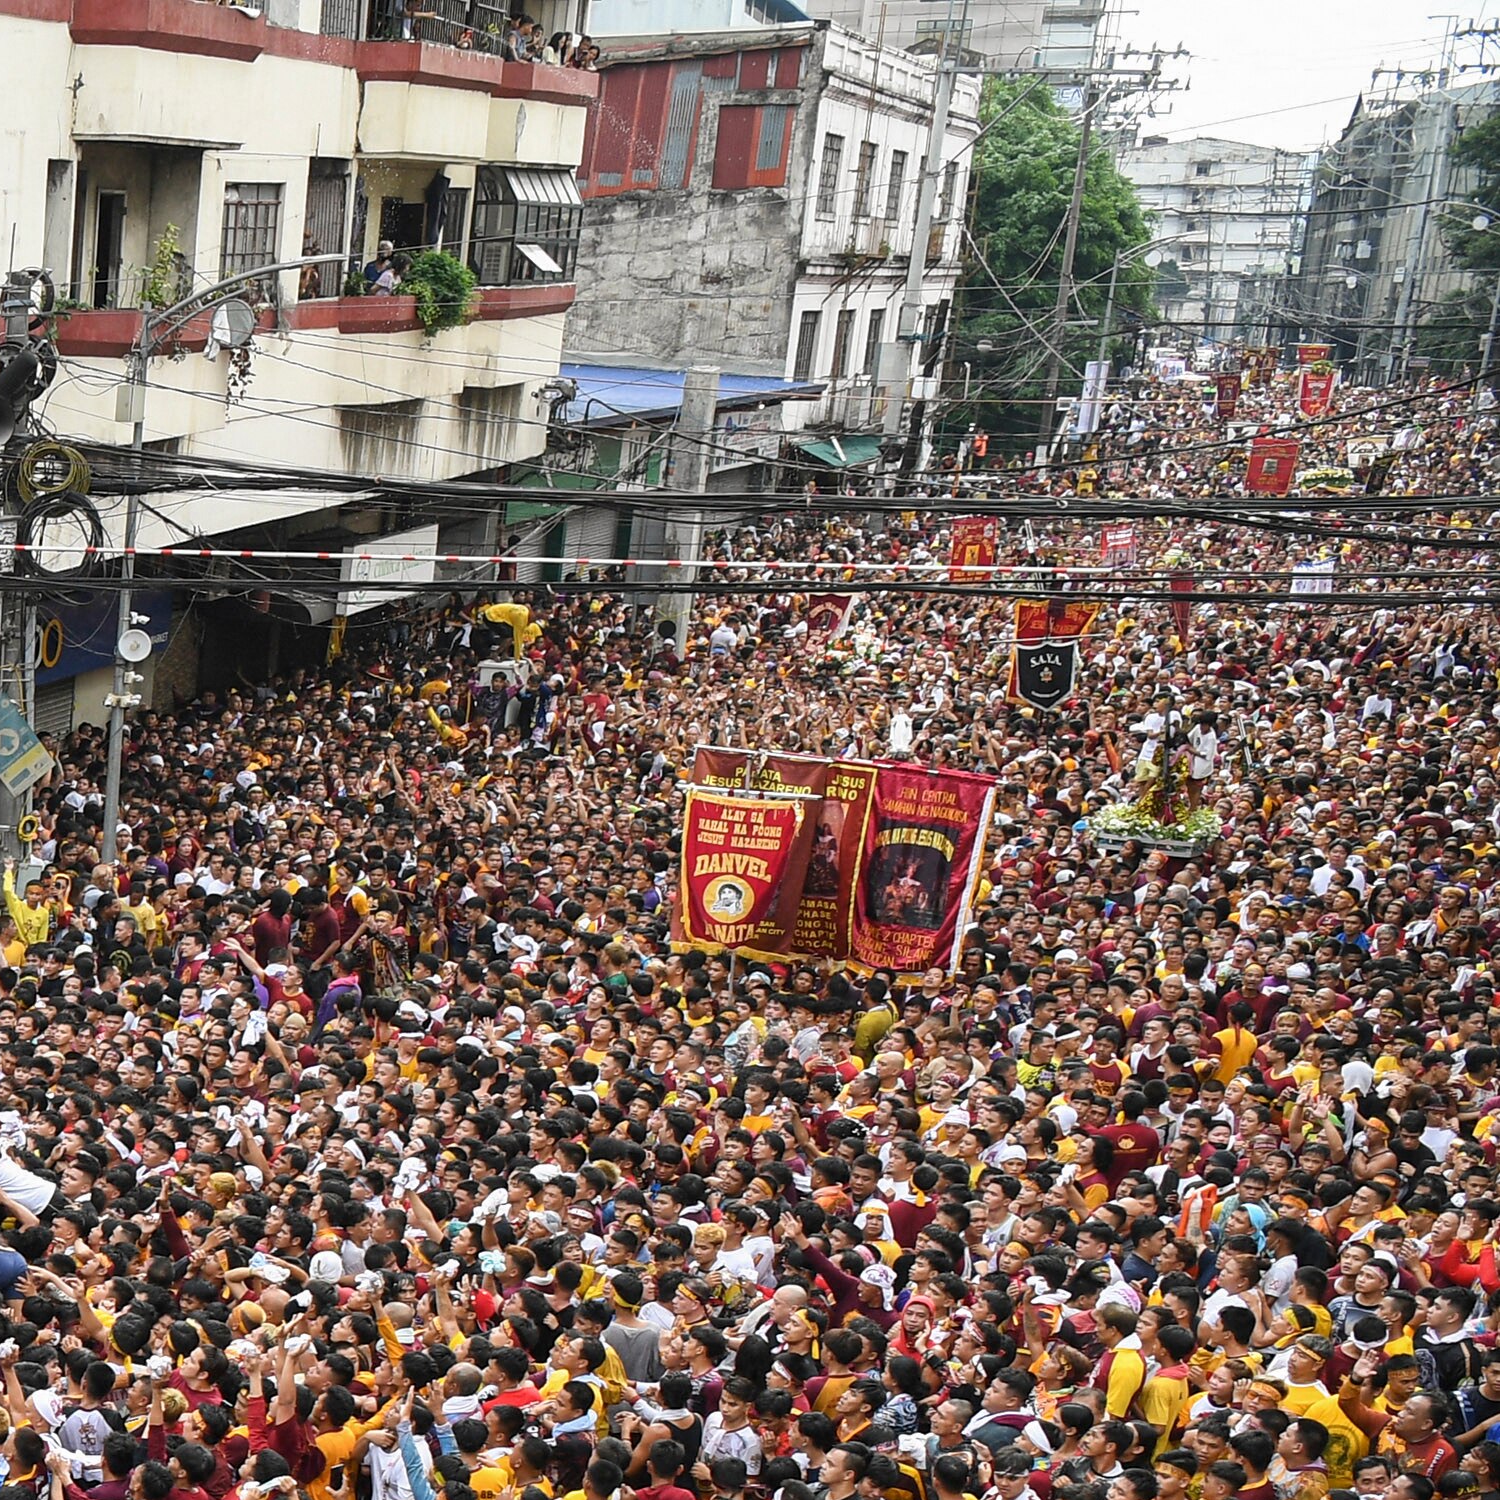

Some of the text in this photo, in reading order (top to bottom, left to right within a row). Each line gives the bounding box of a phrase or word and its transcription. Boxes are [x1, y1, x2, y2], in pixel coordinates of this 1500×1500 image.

[702, 775, 742, 788] JESUS
[736, 767, 782, 782] PAATA
[922, 790, 957, 805] CENTRAL
[721, 809, 764, 823] ALAY SA
[698, 818, 782, 838] MAHAL NA POONG
[697, 832, 780, 850] JESUS NAZARENO
[694, 853, 772, 883] DANVEL
[883, 931, 890, 941] 2
[896, 944, 933, 960] SILANG
